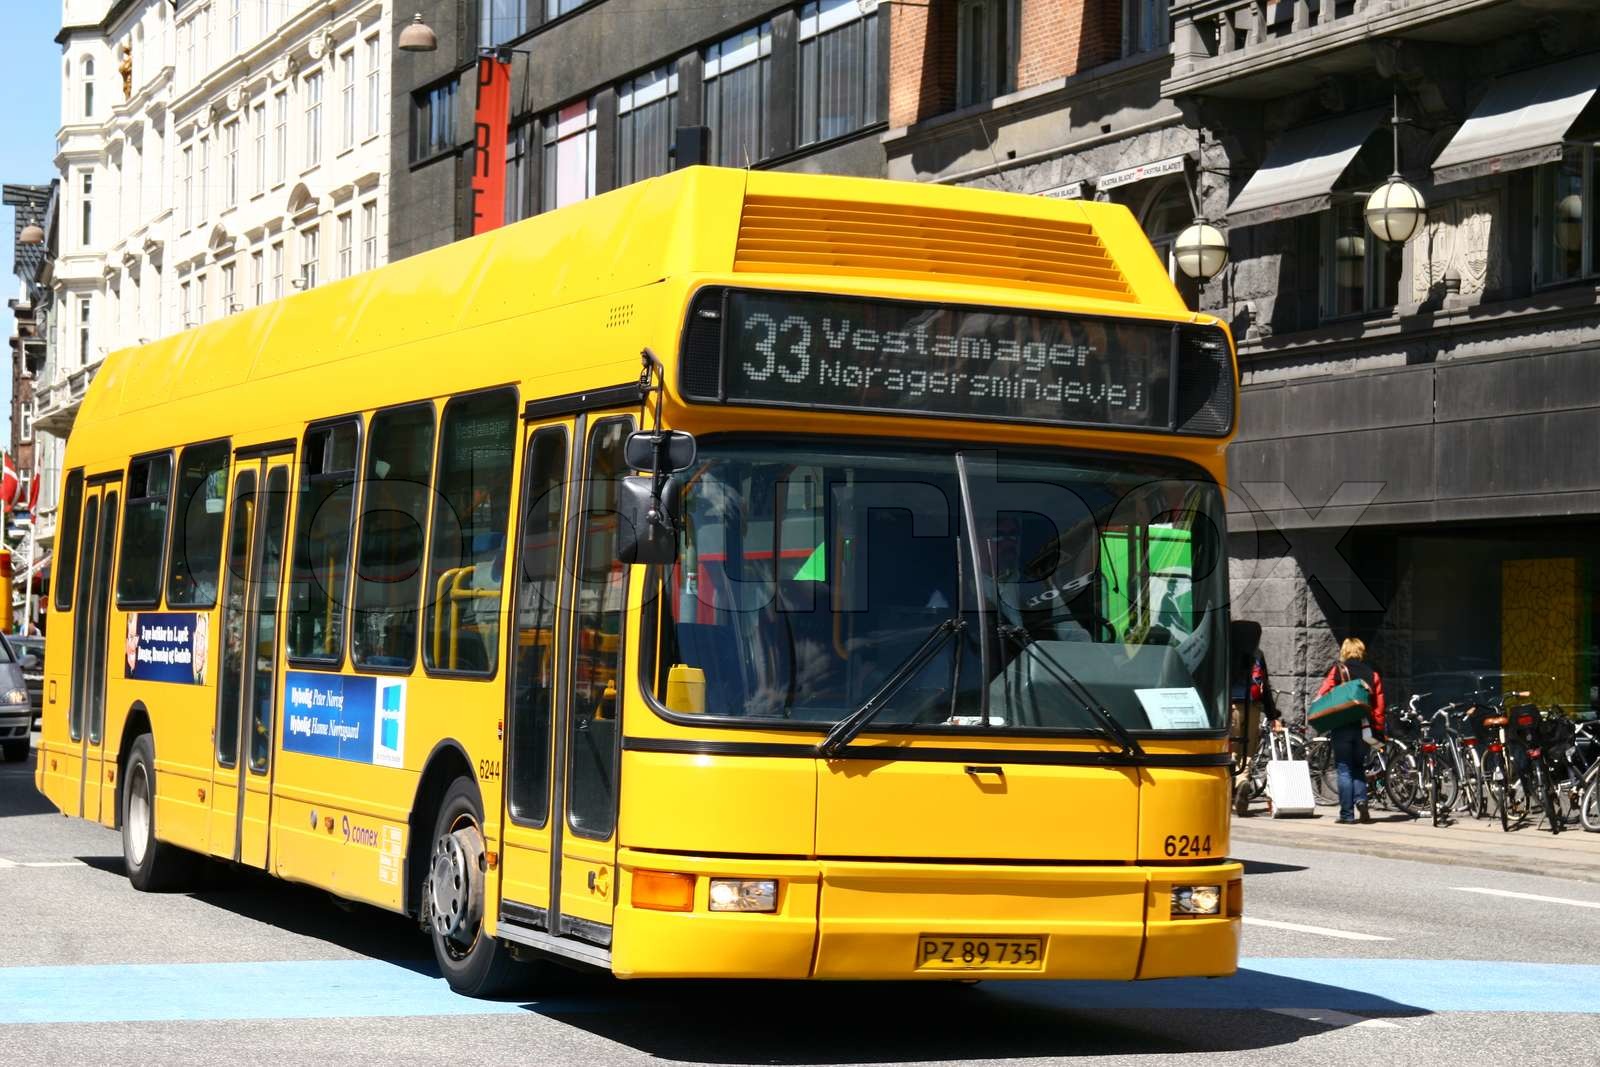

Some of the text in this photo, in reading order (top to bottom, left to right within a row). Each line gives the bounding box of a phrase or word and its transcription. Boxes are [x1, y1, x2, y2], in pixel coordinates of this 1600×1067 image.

[742, 312, 1097, 385] 33 Vestamager
[819, 359, 1143, 409] Nøragersmindevej
[480, 759, 500, 780] 6244
[351, 826, 379, 848] connex
[1164, 835, 1211, 857] 6244
[923, 941, 1037, 965] PZ 89 735
